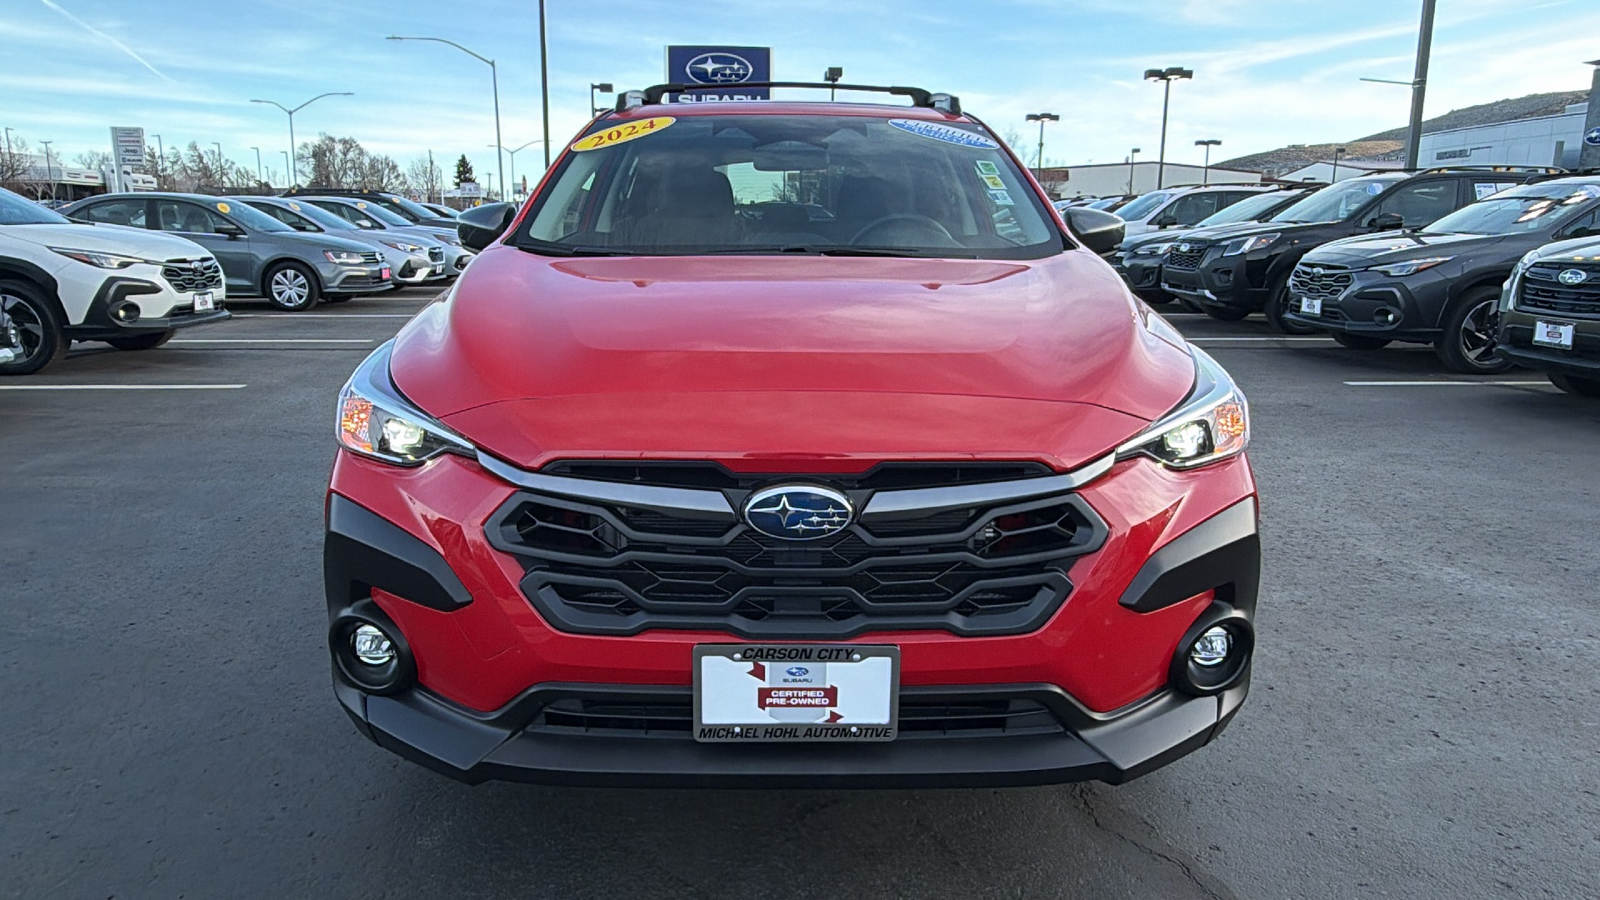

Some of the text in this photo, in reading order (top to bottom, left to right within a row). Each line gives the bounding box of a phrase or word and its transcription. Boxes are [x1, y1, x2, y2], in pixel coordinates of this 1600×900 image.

[591, 119, 656, 148] 2024
[742, 647, 855, 660] CARSON CITY
[771, 690, 825, 698] CERTIFIED
[699, 727, 893, 739] MICHAEL HOHL AUTOMOTIVE
